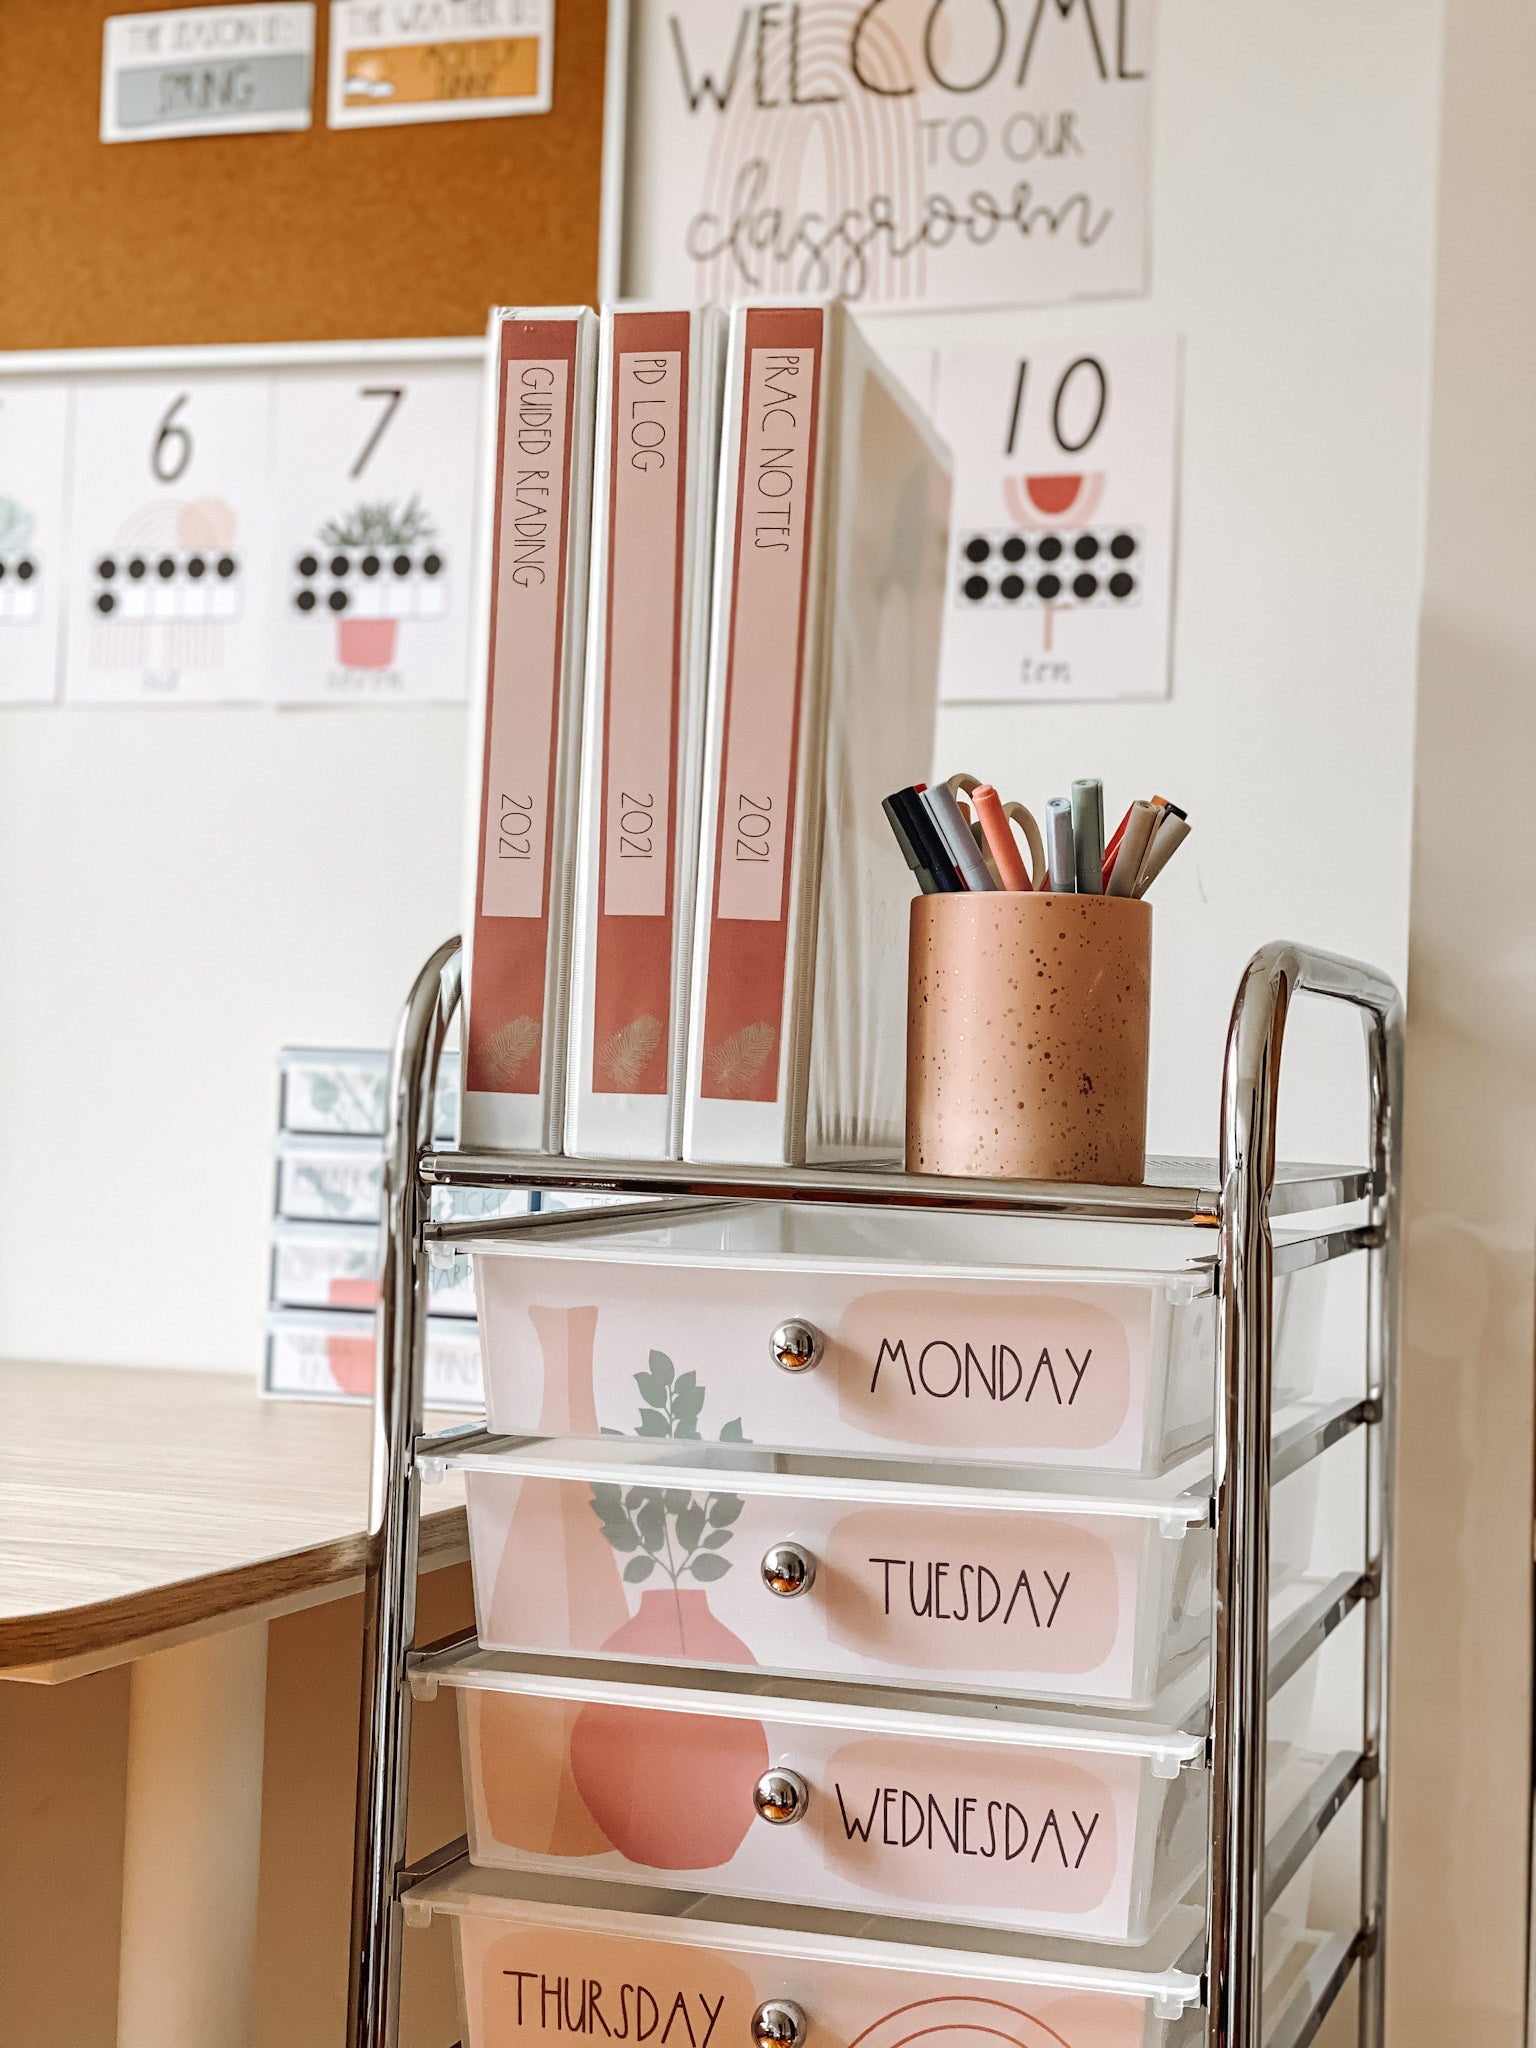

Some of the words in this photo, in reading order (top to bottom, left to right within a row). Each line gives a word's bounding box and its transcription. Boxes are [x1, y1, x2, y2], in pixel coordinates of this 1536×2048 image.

[669, 0, 1148, 113] WELCOME
[915, 115, 987, 167] TO
[1000, 110, 1085, 163] OUR
[685, 158, 1114, 300] classroom
[632, 358, 667, 385] PD
[762, 355, 799, 432] PRAC
[1004, 357, 1107, 454] 10
[150, 391, 194, 483] 6
[350, 385, 407, 480] 7
[518, 367, 555, 455] GUIDED
[631, 400, 666, 473] LOG
[512, 470, 550, 588] READING
[754, 448, 794, 552] NOTES
[498, 793, 533, 860] 2021
[620, 791, 654, 859] 2021
[736, 794, 772, 863] 2021
[870, 1337, 1092, 1405] MONDAY
[868, 1557, 1070, 1628] TUESDAY
[834, 1784, 1099, 1870] WEDNESDAY
[503, 1970, 725, 2048] THURSDAY
